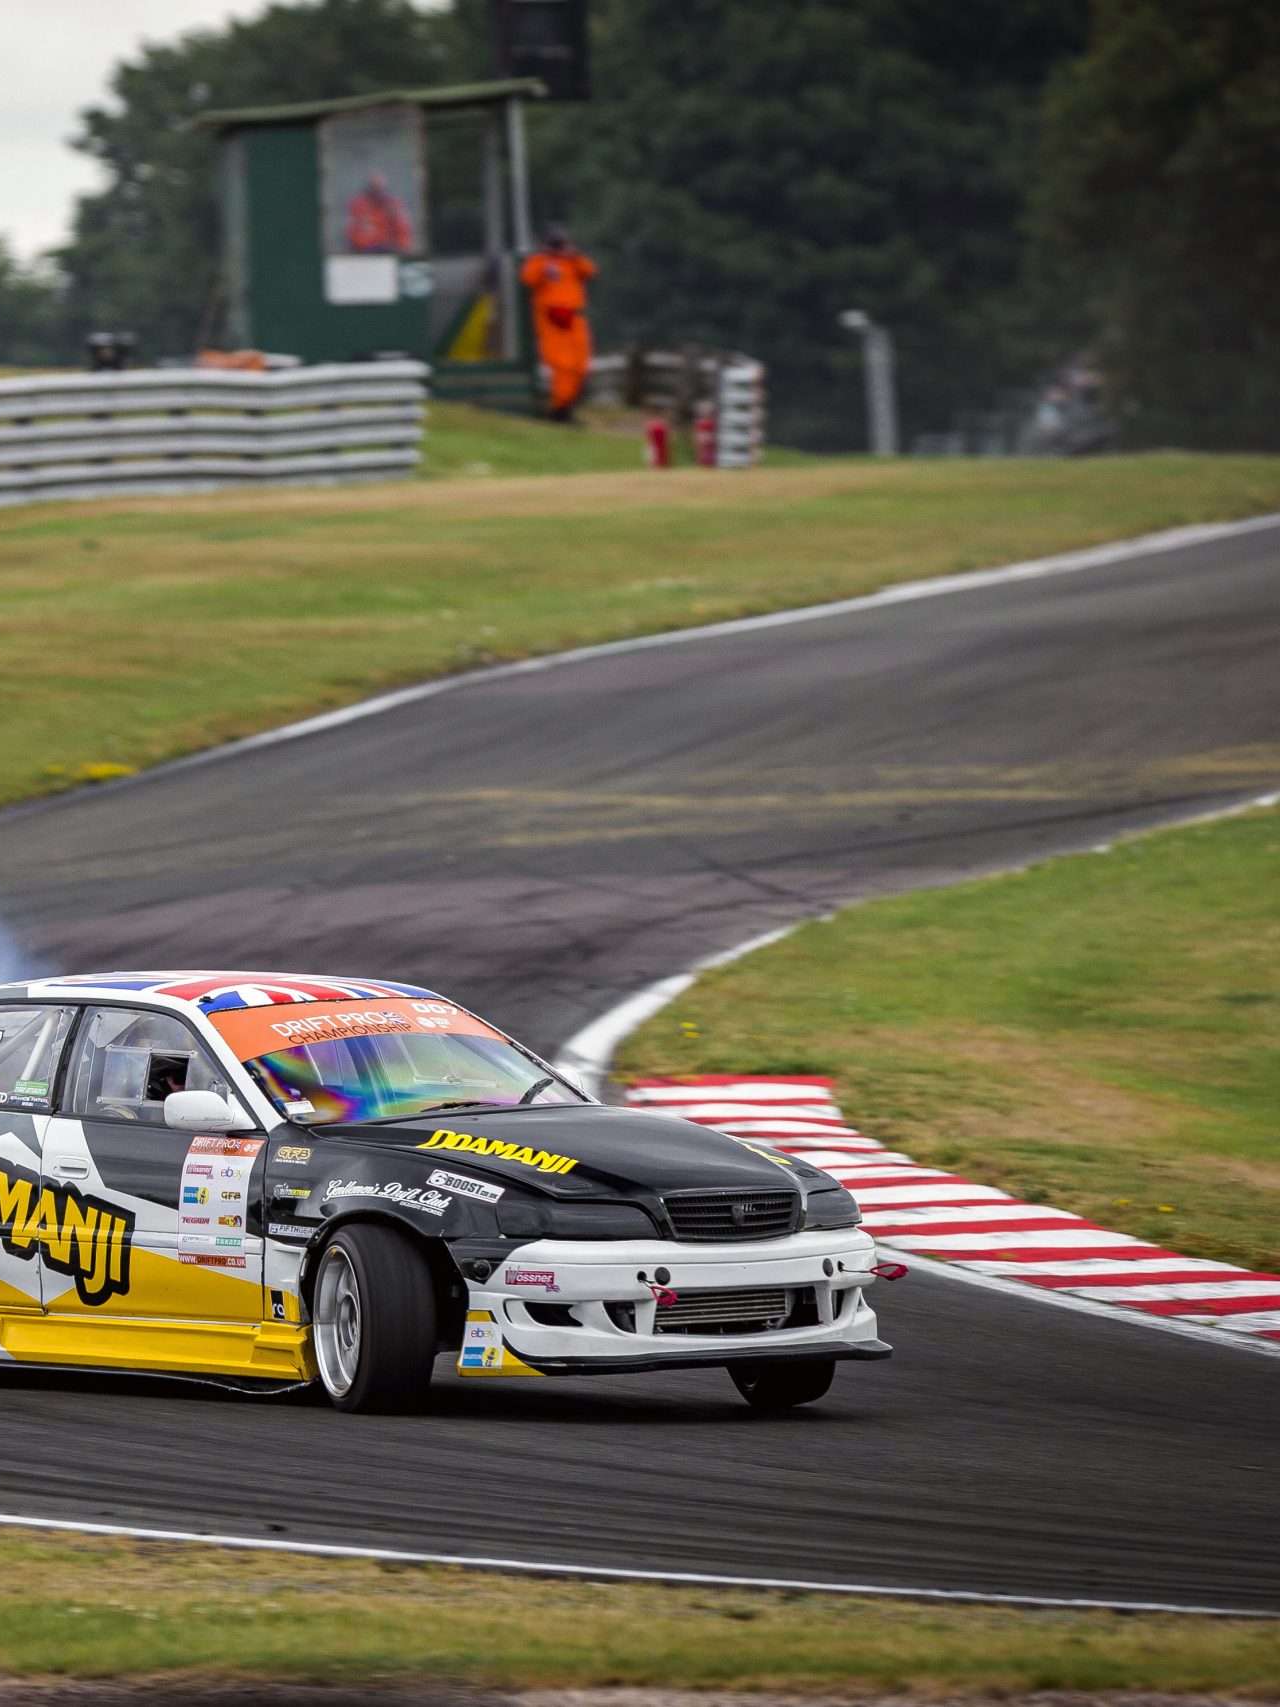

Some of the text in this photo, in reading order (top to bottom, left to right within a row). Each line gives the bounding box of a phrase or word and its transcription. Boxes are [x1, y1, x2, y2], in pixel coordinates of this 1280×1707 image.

[410, 1002, 458, 1016] 007
[271, 1012, 386, 1037] DRIFT PRO
[288, 1023, 412, 1045] CHAMPIONSHIP
[191, 1137, 217, 1147] DRIFT
[216, 1139, 236, 1148] PRO
[415, 1129, 580, 1174] DOAMANJI
[277, 1146, 311, 1160] GFB
[220, 1165, 243, 1180] ebay
[322, 1179, 453, 1209] Gentlemen's Drift Club
